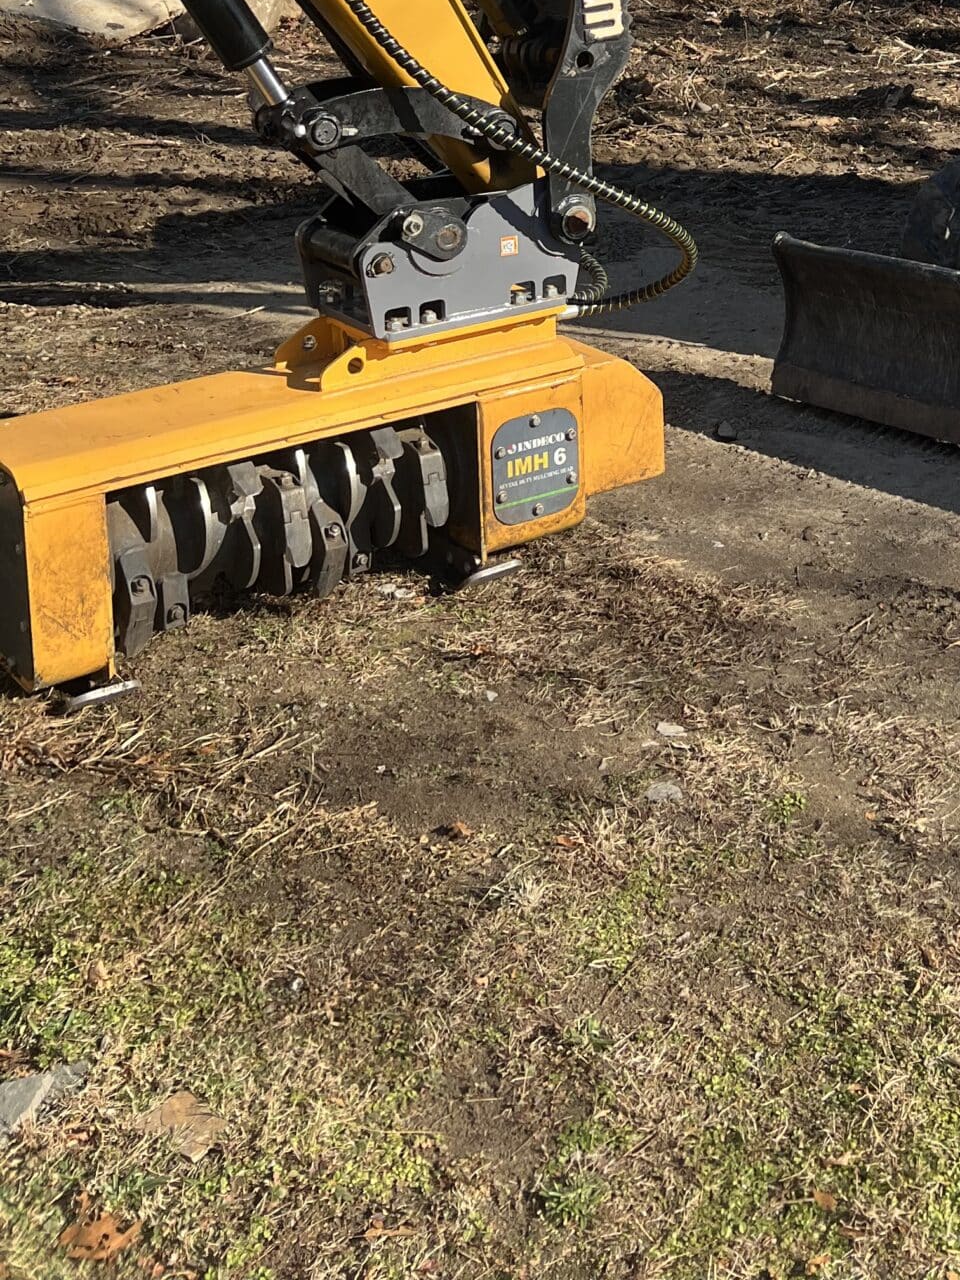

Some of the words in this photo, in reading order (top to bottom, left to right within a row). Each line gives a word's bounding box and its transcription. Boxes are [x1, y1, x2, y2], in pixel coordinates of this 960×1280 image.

[518, 431, 565, 453] INDECO
[507, 451, 549, 479] IMH
[553, 447, 567, 466] 6
